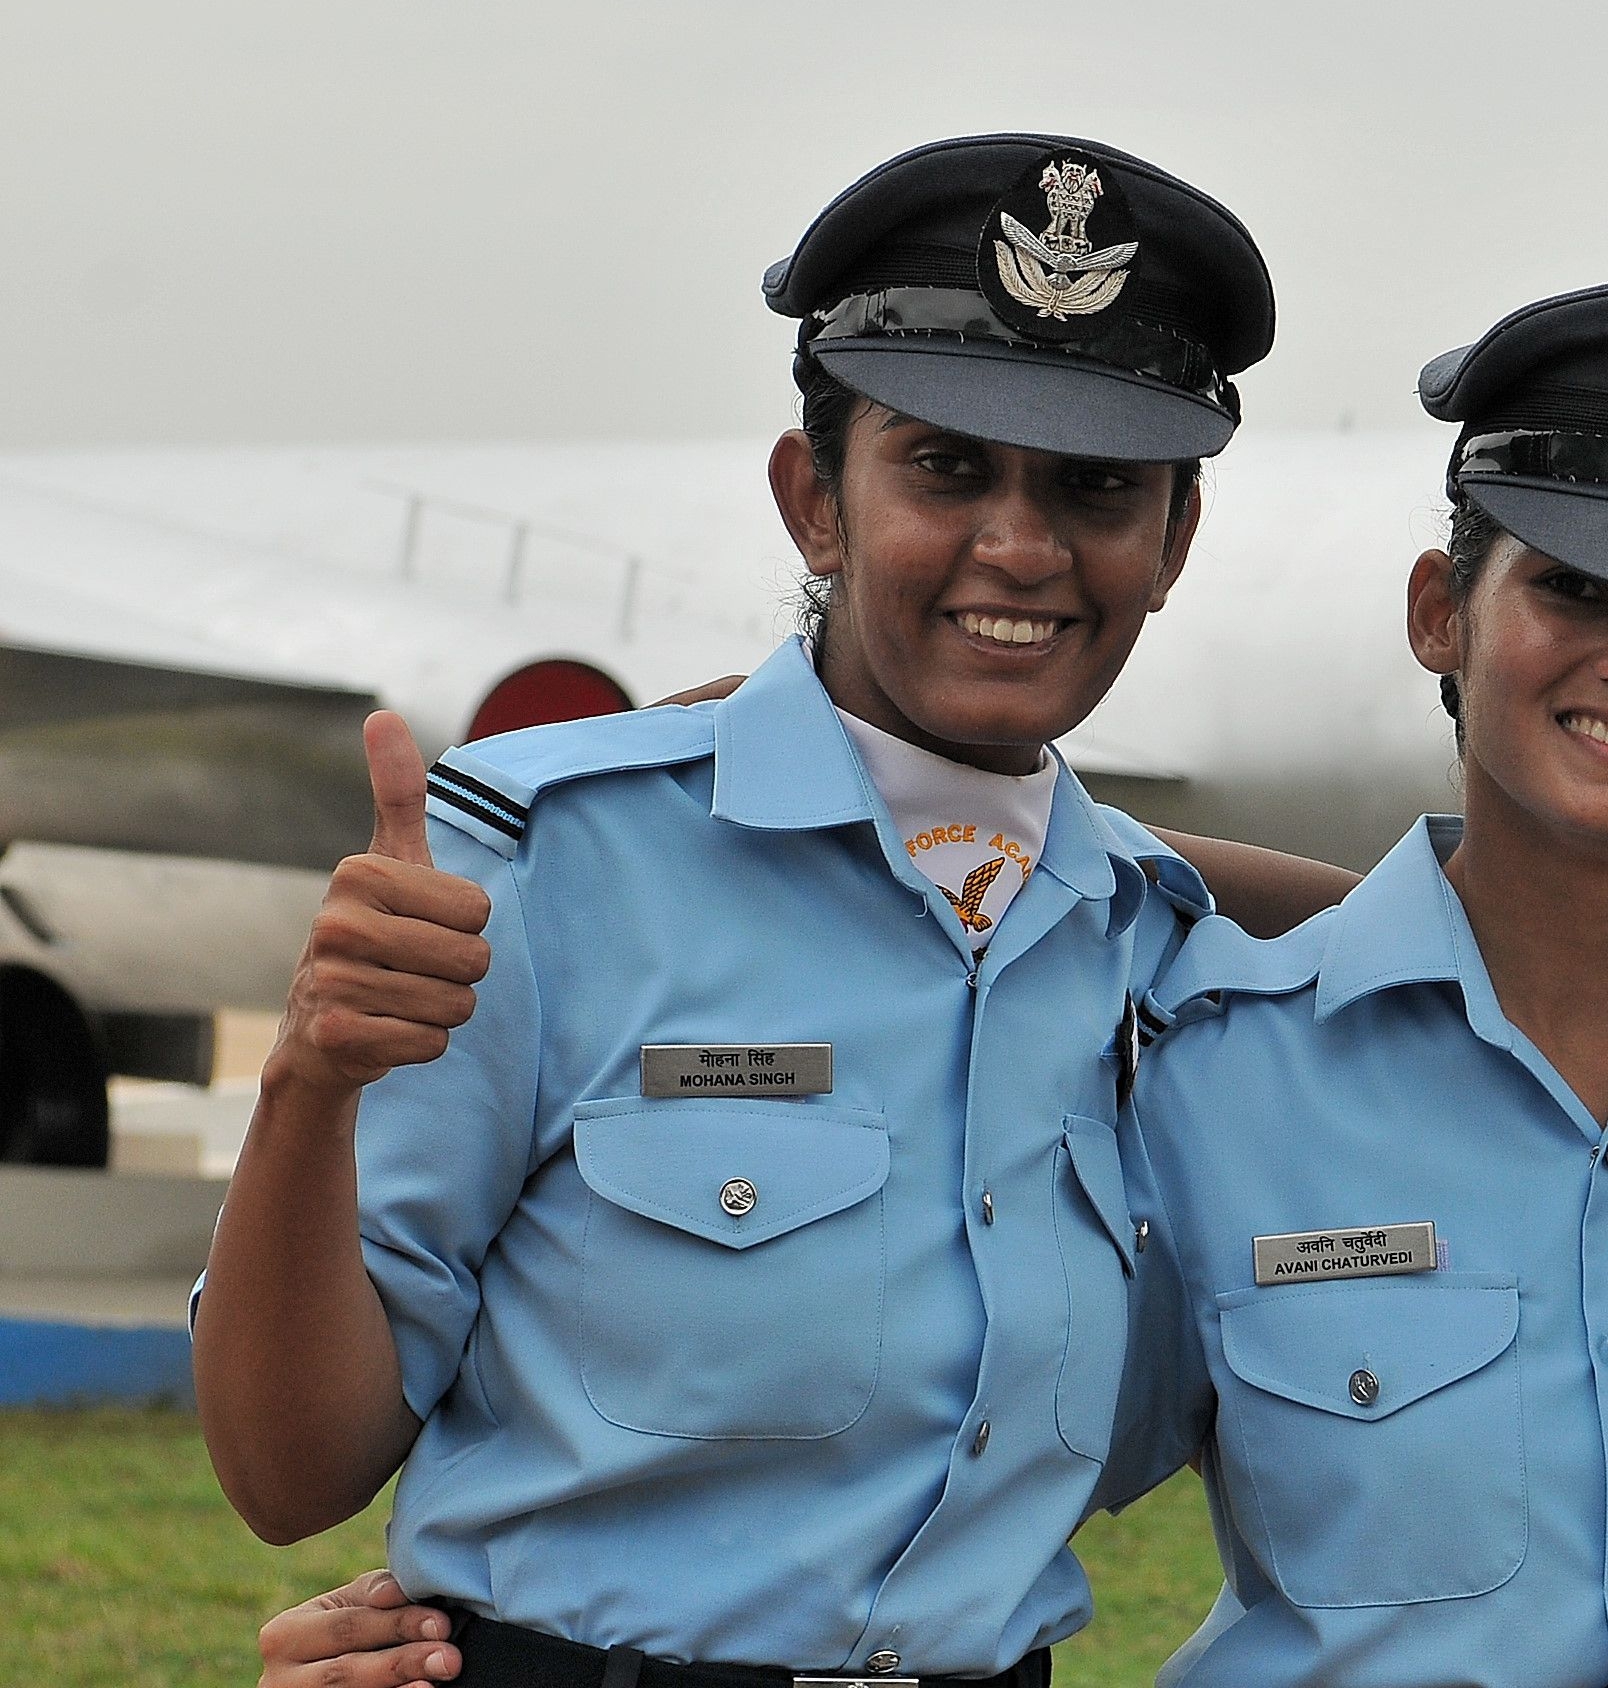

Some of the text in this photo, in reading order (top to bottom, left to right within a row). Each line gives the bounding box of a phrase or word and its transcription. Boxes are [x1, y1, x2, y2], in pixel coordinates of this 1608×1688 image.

[904, 824, 977, 857] FORCE
[747, 1048, 776, 1066] सिंह
[679, 1072, 795, 1087] MOHANA SINGH
[1296, 1231, 1387, 1254] अवनि चतुर्वेदी
[1274, 1251, 1413, 1275] AVANI CHATURVEDI
